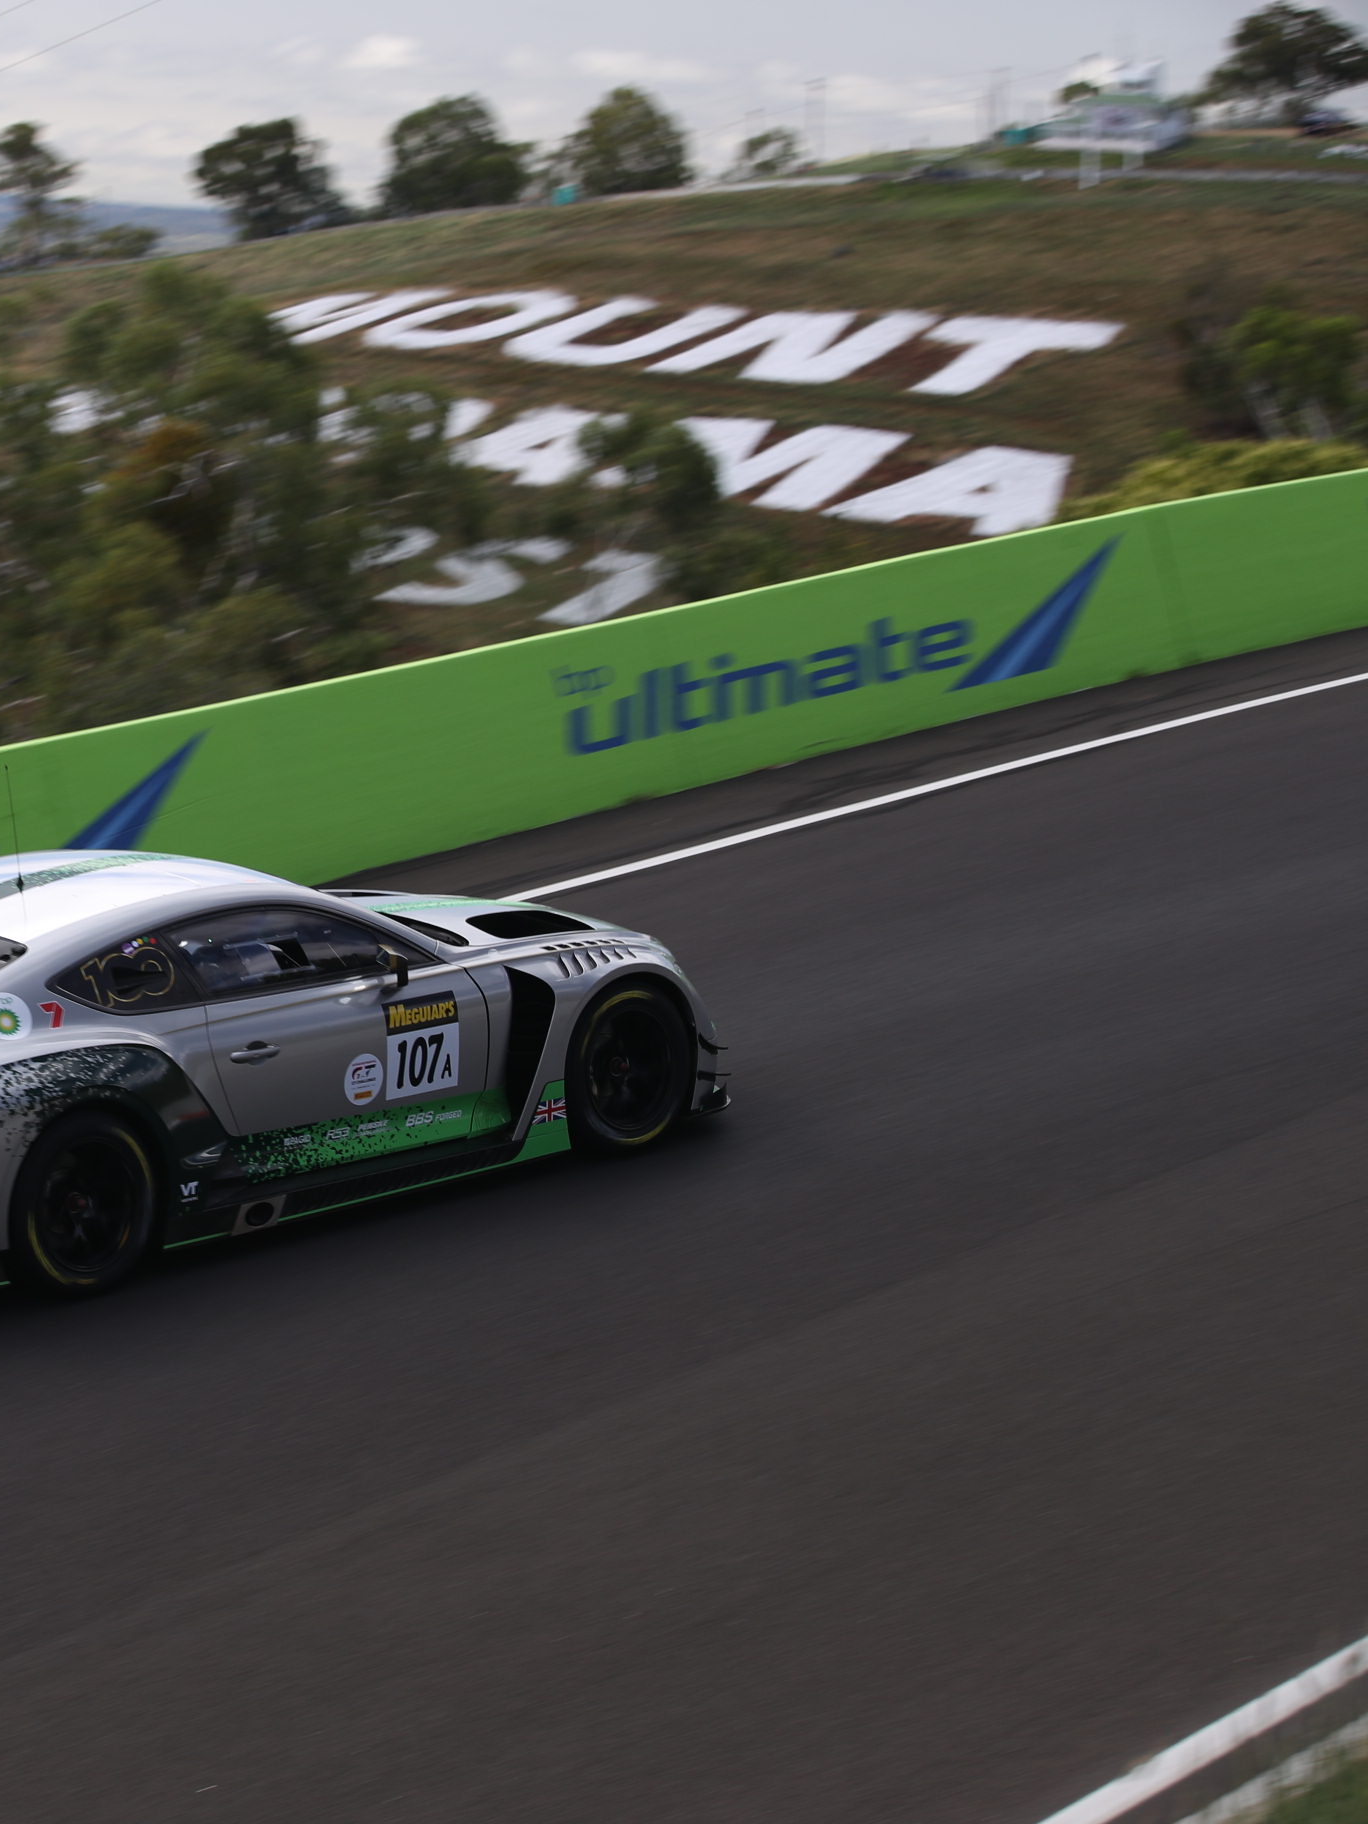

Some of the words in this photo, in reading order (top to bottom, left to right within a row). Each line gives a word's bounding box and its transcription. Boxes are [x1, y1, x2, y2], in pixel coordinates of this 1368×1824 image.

[268, 286, 1126, 397] MOUNT
[549, 664, 615, 697] bp
[563, 616, 977, 755] ultimate
[405, 1110, 434, 1127] BBS
